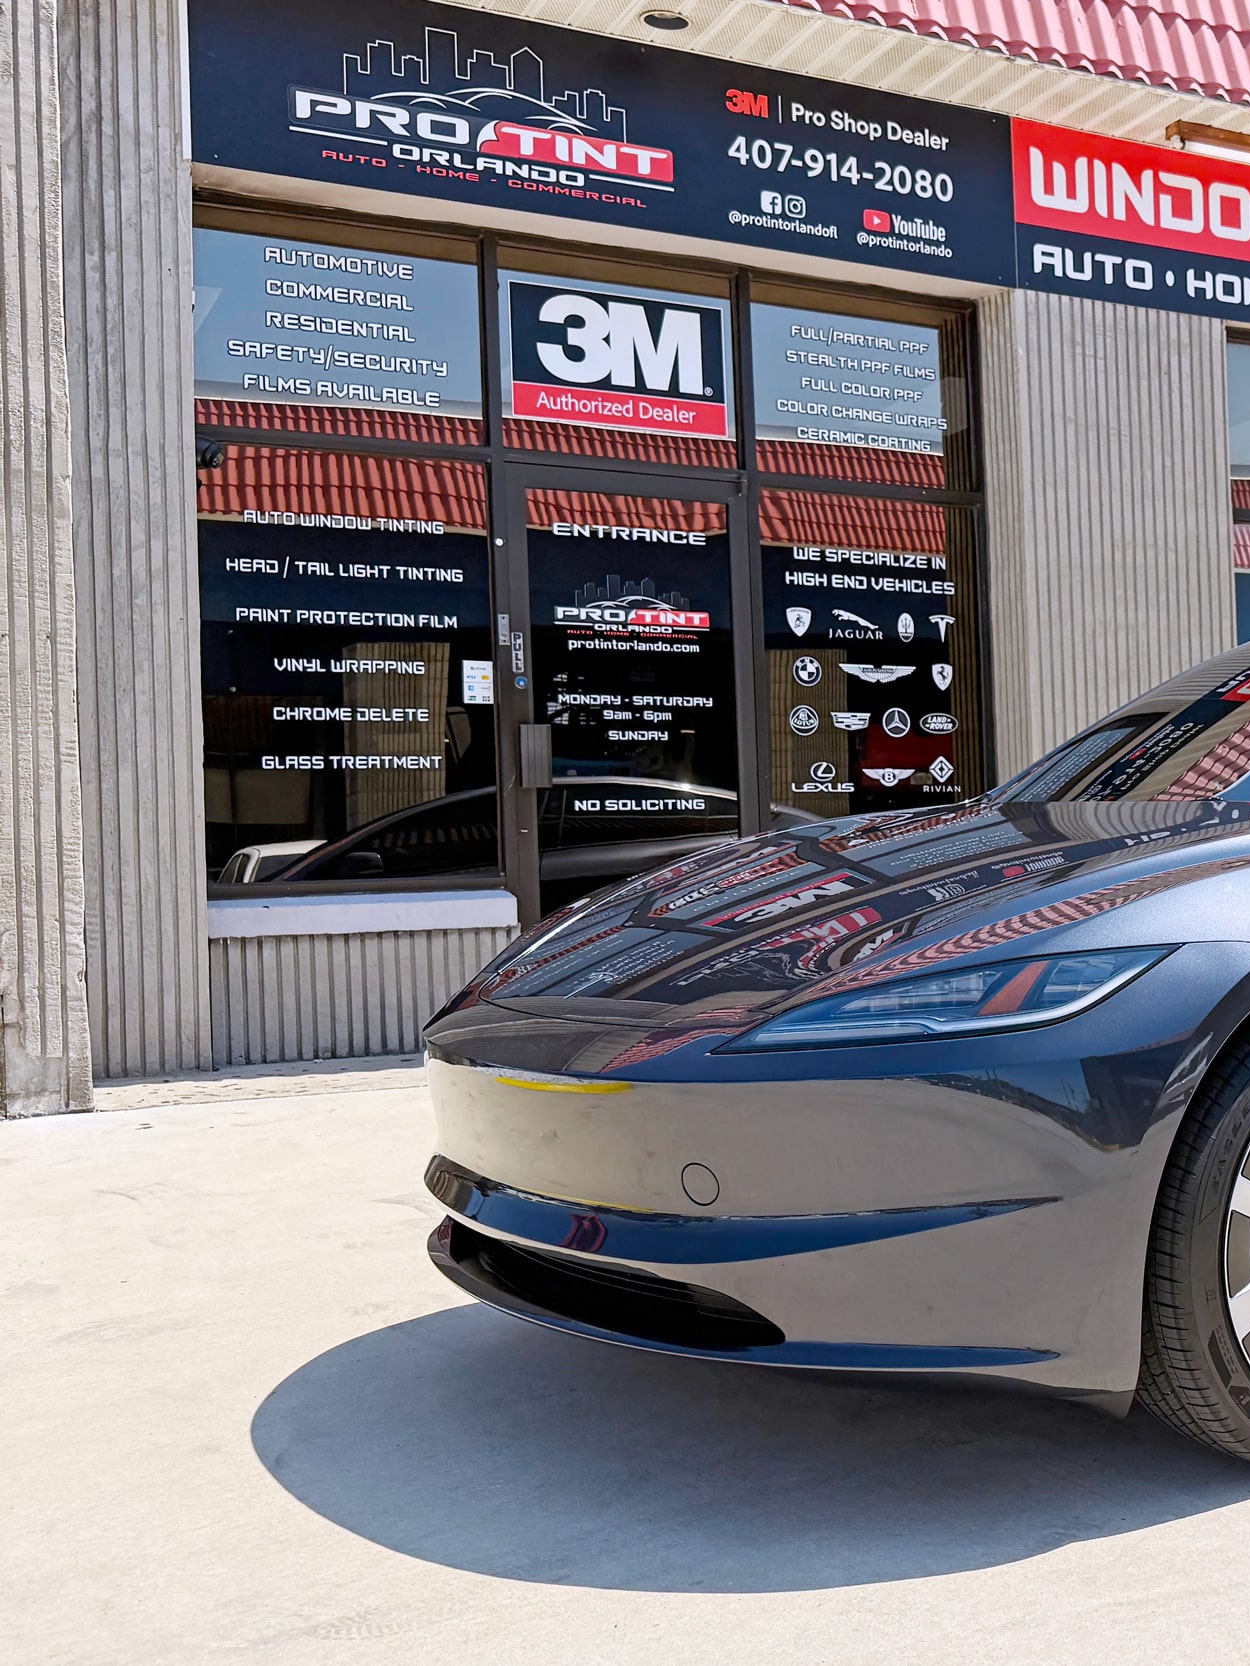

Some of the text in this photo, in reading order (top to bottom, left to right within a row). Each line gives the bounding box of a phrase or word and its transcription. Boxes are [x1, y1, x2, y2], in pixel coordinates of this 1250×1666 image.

[295, 90, 668, 175] PRO TINT
[725, 88, 949, 151] 3M Pro Shop Dealer
[392, 143, 585, 187] ORLANDO
[728, 136, 954, 203] 407-914-2080
[322, 150, 387, 168] AUTO
[416, 164, 480, 182] HOME
[508, 179, 647, 208] COMMERCIAL
[728, 209, 838, 239] @protintorlandofl
[892, 214, 946, 243] YouTube
[856, 231, 953, 258] @protintorlando
[264, 246, 414, 280] AUTOMOTIVE
[1033, 243, 1154, 290] AUTO
[265, 279, 414, 311] COMMERCIAL
[265, 310, 416, 343] RESIDENTIAL
[791, 324, 929, 355] FULL/PARTIAL PPF
[536, 294, 704, 395] 3M
[227, 339, 448, 378] SAFETY/SECURITY
[786, 349, 936, 381] STEALTH PPF FILMS
[243, 373, 441, 408] FILMS AVAILABLE
[801, 376, 924, 402] FULL COLOR PPF
[536, 391, 697, 424] Authorized Dealer
[777, 399, 948, 431] COLOR CHANGE WRAPS
[797, 426, 931, 453] CERAMIC COATING
[243, 509, 445, 535] AUTO WINDOW TINTING
[552, 522, 707, 546] ENTRANCE
[225, 557, 279, 574] HEAD
[294, 560, 335, 577] TAIL
[338, 563, 392, 580] LIGHT
[395, 566, 464, 583] TINTING
[793, 546, 947, 570] WE SPECIALIZE IN
[785, 571, 956, 596] HIGH END VEHICLES
[235, 607, 458, 629] PAINT PROTECTION FILM
[556, 606, 709, 626] PRO TINT
[594, 623, 673, 634] ORLANDO
[567, 638, 700, 653] protintorlando.com
[640, 632, 699, 640] COMMERCIAL
[828, 628, 884, 641] JAGUAR
[513, 632, 523, 671] PULL
[273, 657, 426, 675] VINYL WRAPPING
[557, 694, 622, 706] MONDAY
[632, 695, 714, 707] SATURDAY
[272, 706, 430, 722] CHROME DELETE
[602, 709, 632, 721] 9am
[643, 710, 672, 724] 6pm
[927, 716, 947, 724] LAND
[607, 730, 669, 742] SUNDAY
[261, 755, 443, 770] GLASS TREATMENT
[791, 782, 855, 793] LEXUS
[923, 785, 962, 793] RIVIAN
[573, 799, 706, 812] NO SOLICITING
